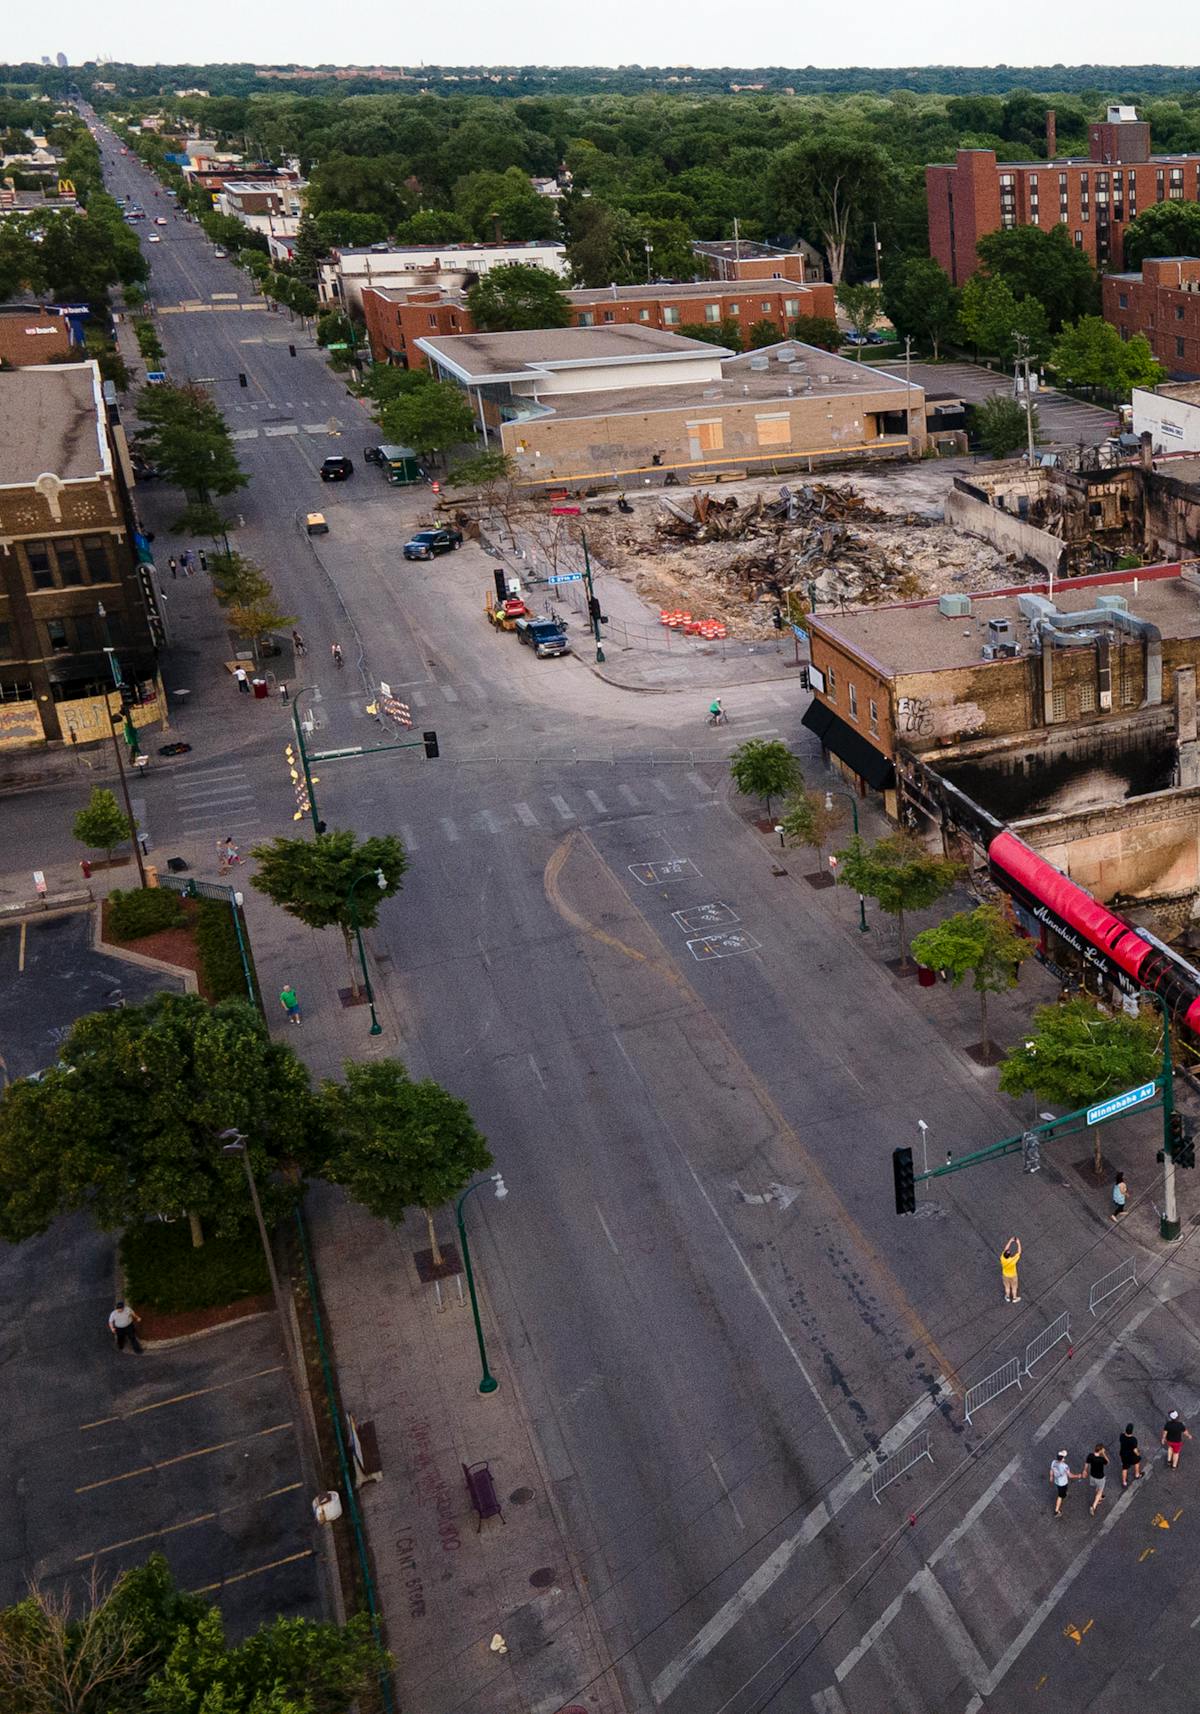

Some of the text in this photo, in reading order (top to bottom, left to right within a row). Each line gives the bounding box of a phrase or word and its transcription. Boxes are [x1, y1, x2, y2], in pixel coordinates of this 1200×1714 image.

[1032, 905, 1083, 951] Minnehaha
[1084, 945, 1109, 974] Lake
[1090, 1087, 1152, 1120] Minnehaha Av
